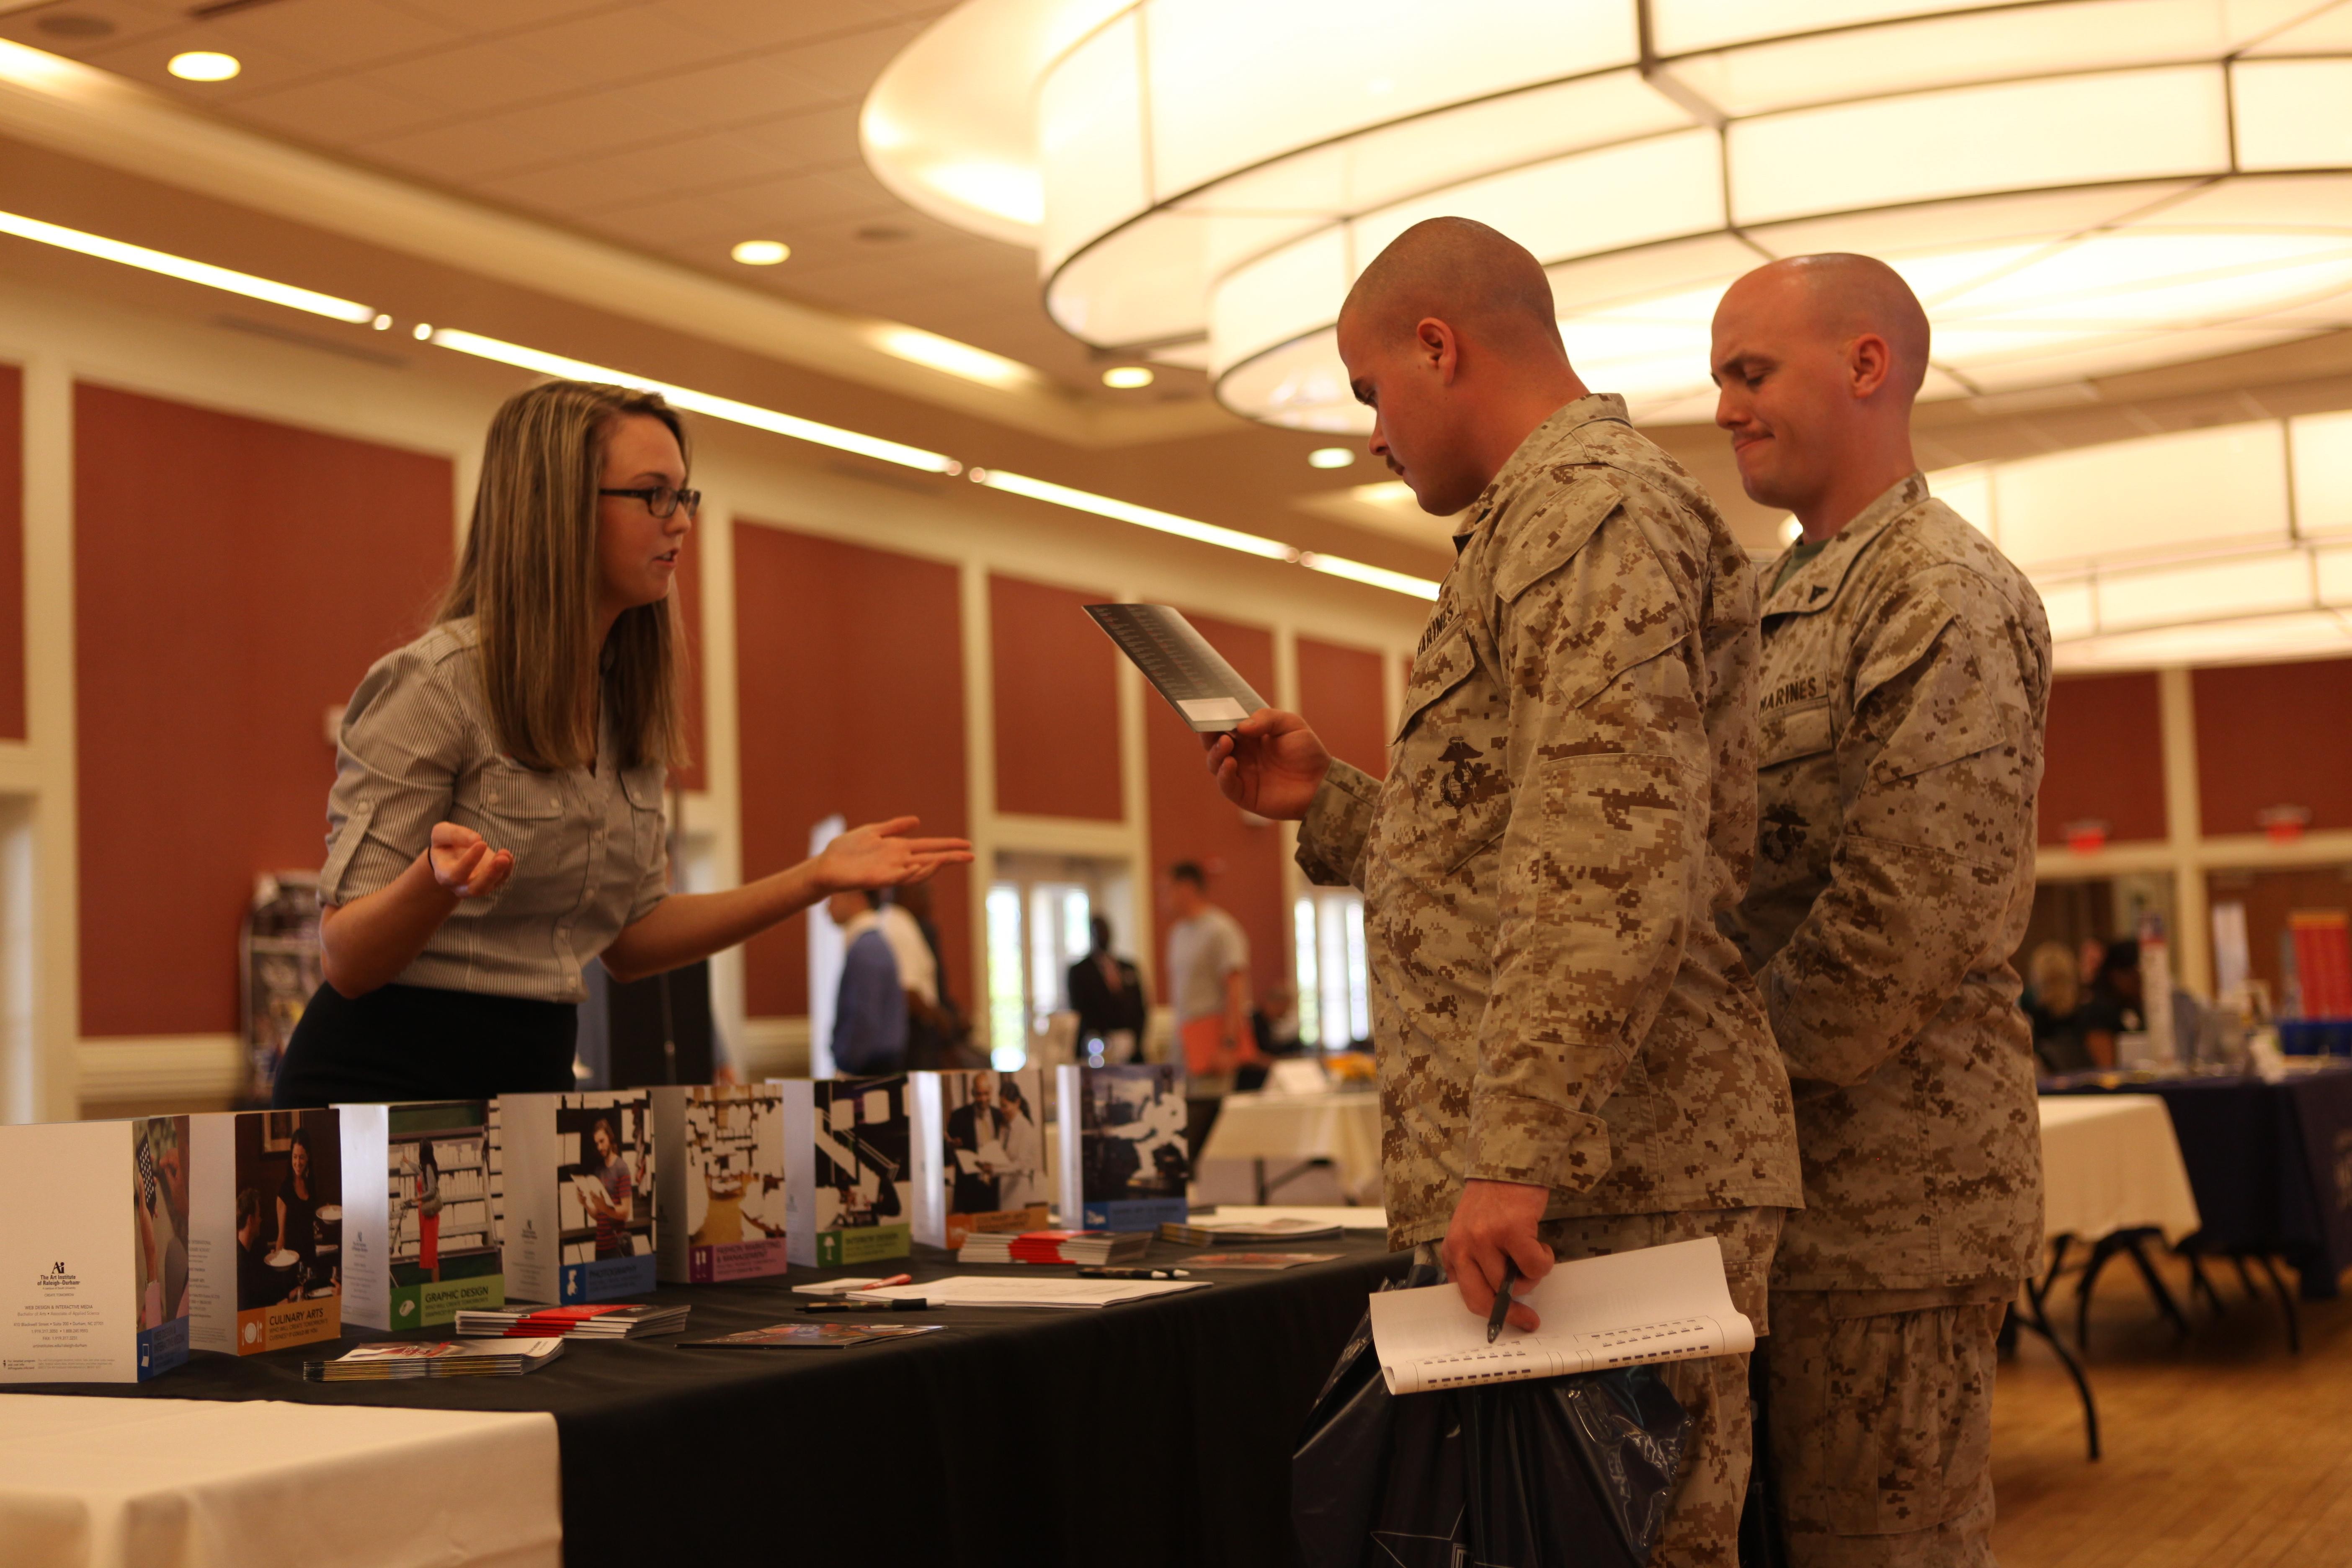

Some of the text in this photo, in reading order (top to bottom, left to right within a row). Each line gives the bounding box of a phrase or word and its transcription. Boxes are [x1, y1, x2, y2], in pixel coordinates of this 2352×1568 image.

[425, 1286, 488, 1303] GRAPHIC DESIGN
[269, 1308, 323, 1326] CULINARY ARTS
